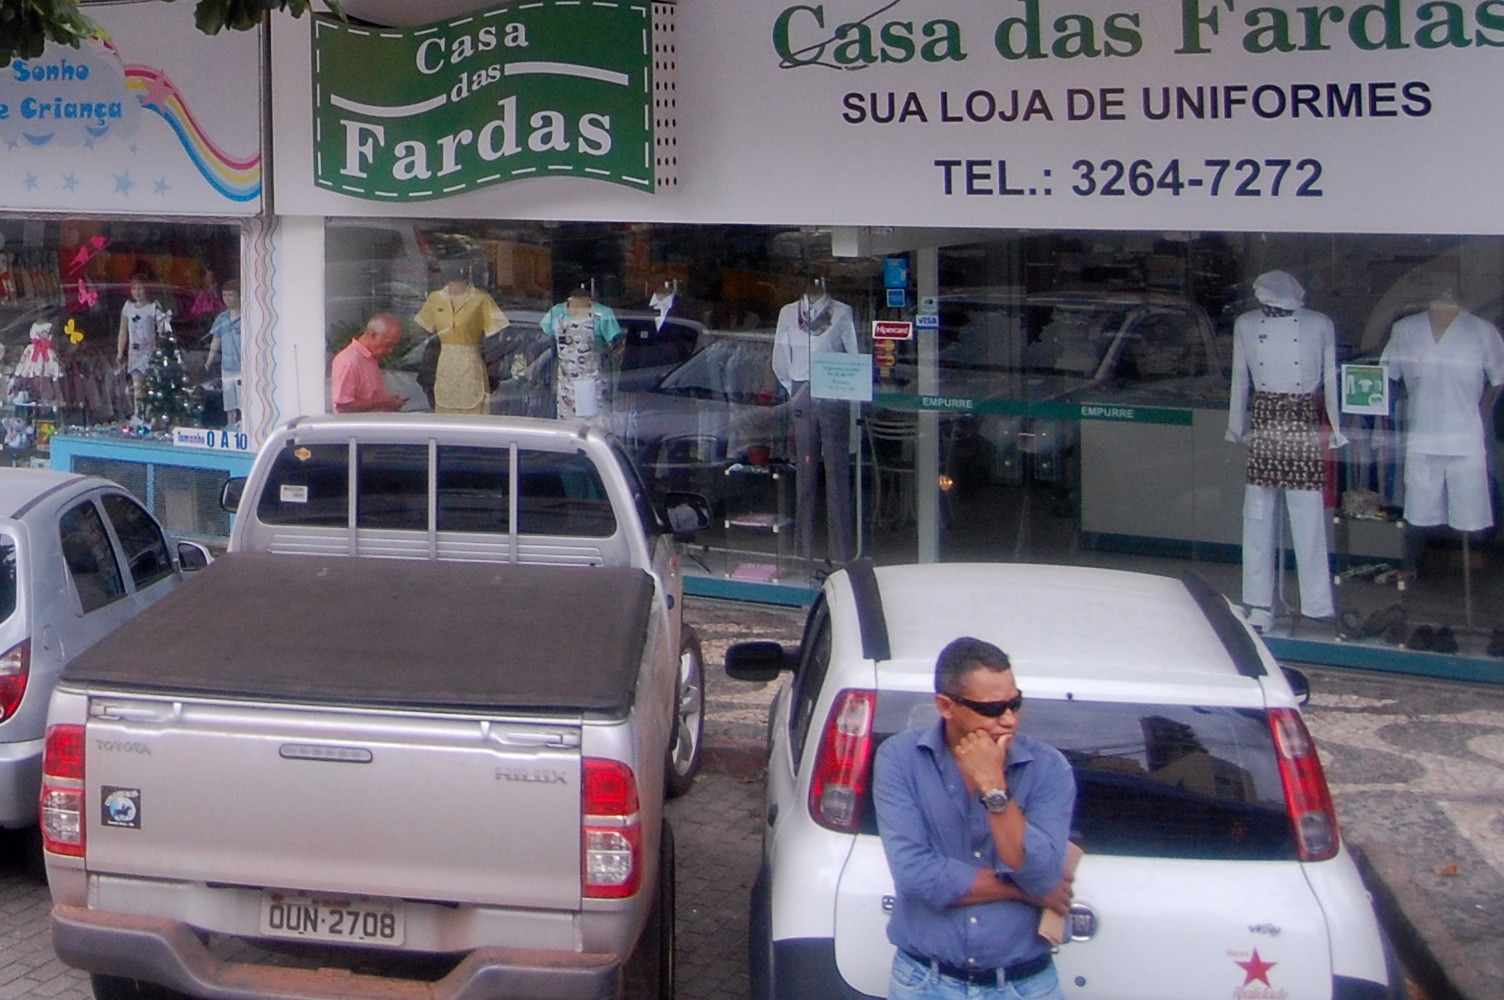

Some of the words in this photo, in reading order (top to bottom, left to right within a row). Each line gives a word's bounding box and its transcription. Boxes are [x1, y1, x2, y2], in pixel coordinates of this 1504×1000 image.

[416, 21, 529, 75] Casa
[773, 4, 967, 67] Casa
[12, 57, 89, 82] Sonho
[450, 63, 501, 102] das
[20, 97, 122, 126] Criança
[842, 90, 928, 125] SUA
[941, 88, 1054, 123] LOJA
[1067, 87, 1127, 121] DE
[1143, 81, 1432, 121] UNIFORMES
[339, 95, 612, 181] Fardas
[935, 159, 1052, 196] TEL.:
[1072, 158, 1323, 198] 3264-7272
[918, 317, 938, 325] VISA
[922, 397, 973, 409] EMPURRE
[1081, 406, 1134, 419] EMPURRE
[220, 431, 229, 449] A
[234, 433, 248, 450] 10
[96, 739, 152, 756] TOYOTA
[496, 765, 568, 784] HILUX
